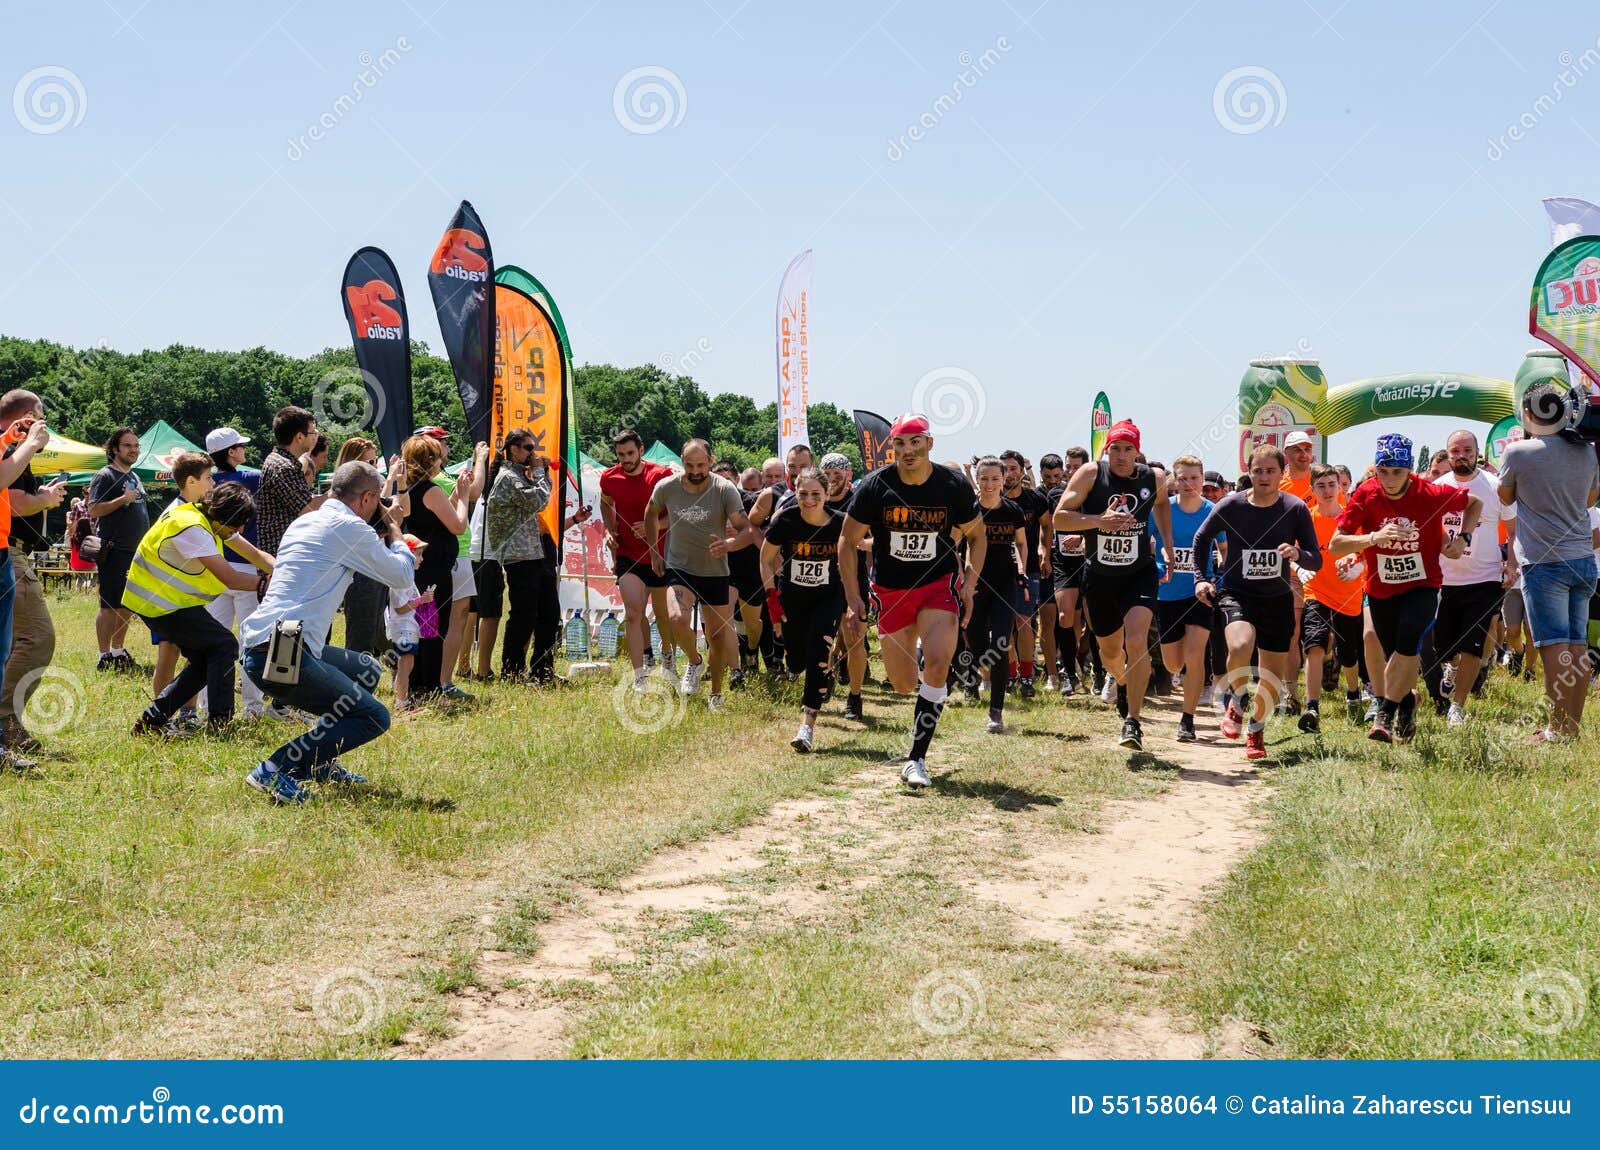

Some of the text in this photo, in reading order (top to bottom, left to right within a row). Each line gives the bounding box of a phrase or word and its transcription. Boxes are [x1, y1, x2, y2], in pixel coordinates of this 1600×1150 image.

[781, 316, 791, 437] S-KARP
[800, 350, 808, 414] terrain
[900, 534, 929, 550] 137
[1103, 538, 1132, 554] 403
[1248, 552, 1277, 567] 440
[1384, 556, 1417, 573] 455
[797, 562, 824, 577] 126
